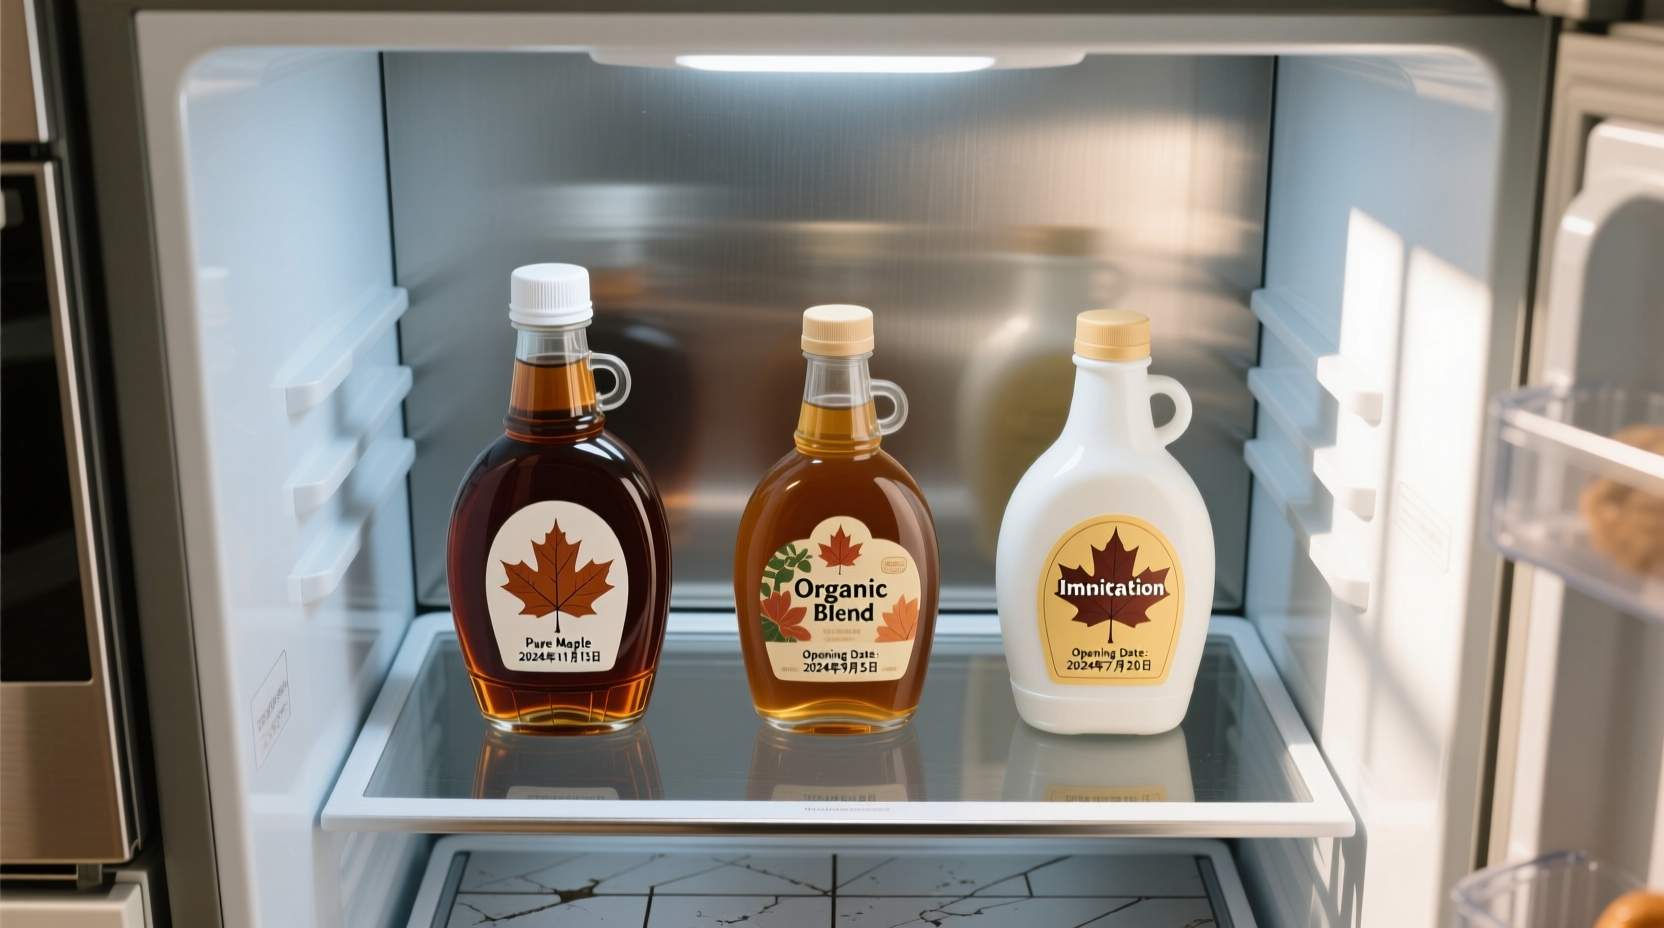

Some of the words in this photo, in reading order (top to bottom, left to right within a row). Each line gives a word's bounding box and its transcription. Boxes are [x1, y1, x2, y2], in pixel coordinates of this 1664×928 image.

[795, 578, 888, 604] Organic
[814, 603, 874, 622] Blend
[526, 637, 552, 648] Pure
[556, 636, 591, 651] Maple
